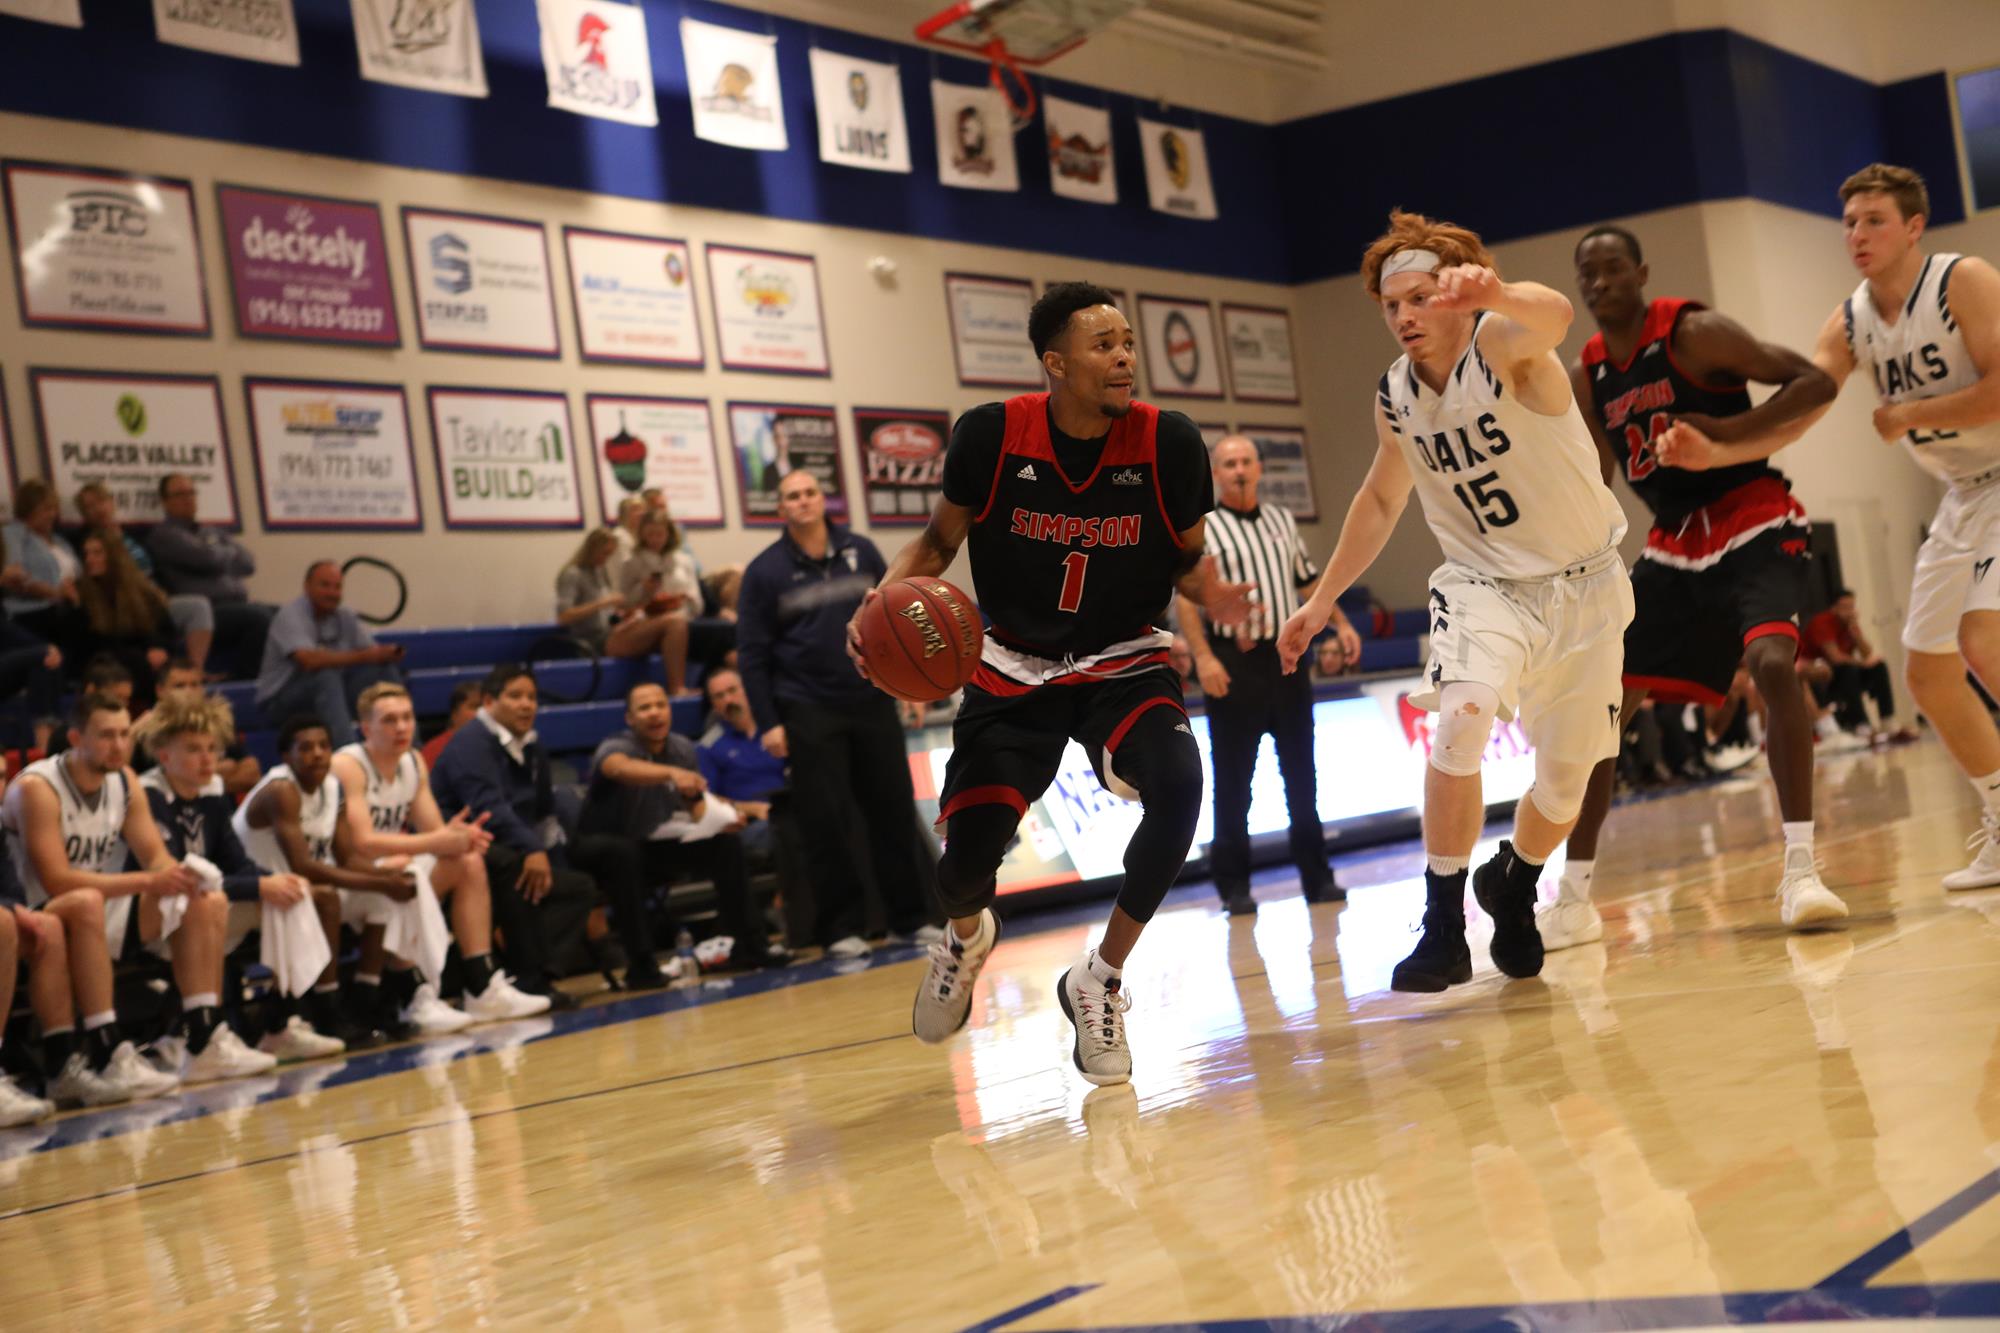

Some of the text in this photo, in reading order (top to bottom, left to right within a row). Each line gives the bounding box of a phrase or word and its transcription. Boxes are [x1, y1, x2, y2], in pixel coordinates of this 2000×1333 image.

[243, 216, 366, 278] decisely
[62, 443, 216, 467] PLACER VALLEY
[447, 416, 528, 458] Taylor
[1414, 412, 1512, 473] OAKS
[1011, 507, 1142, 547] SIMPSON
[1453, 471, 1520, 535] 15
[1058, 551, 1089, 613] 1
